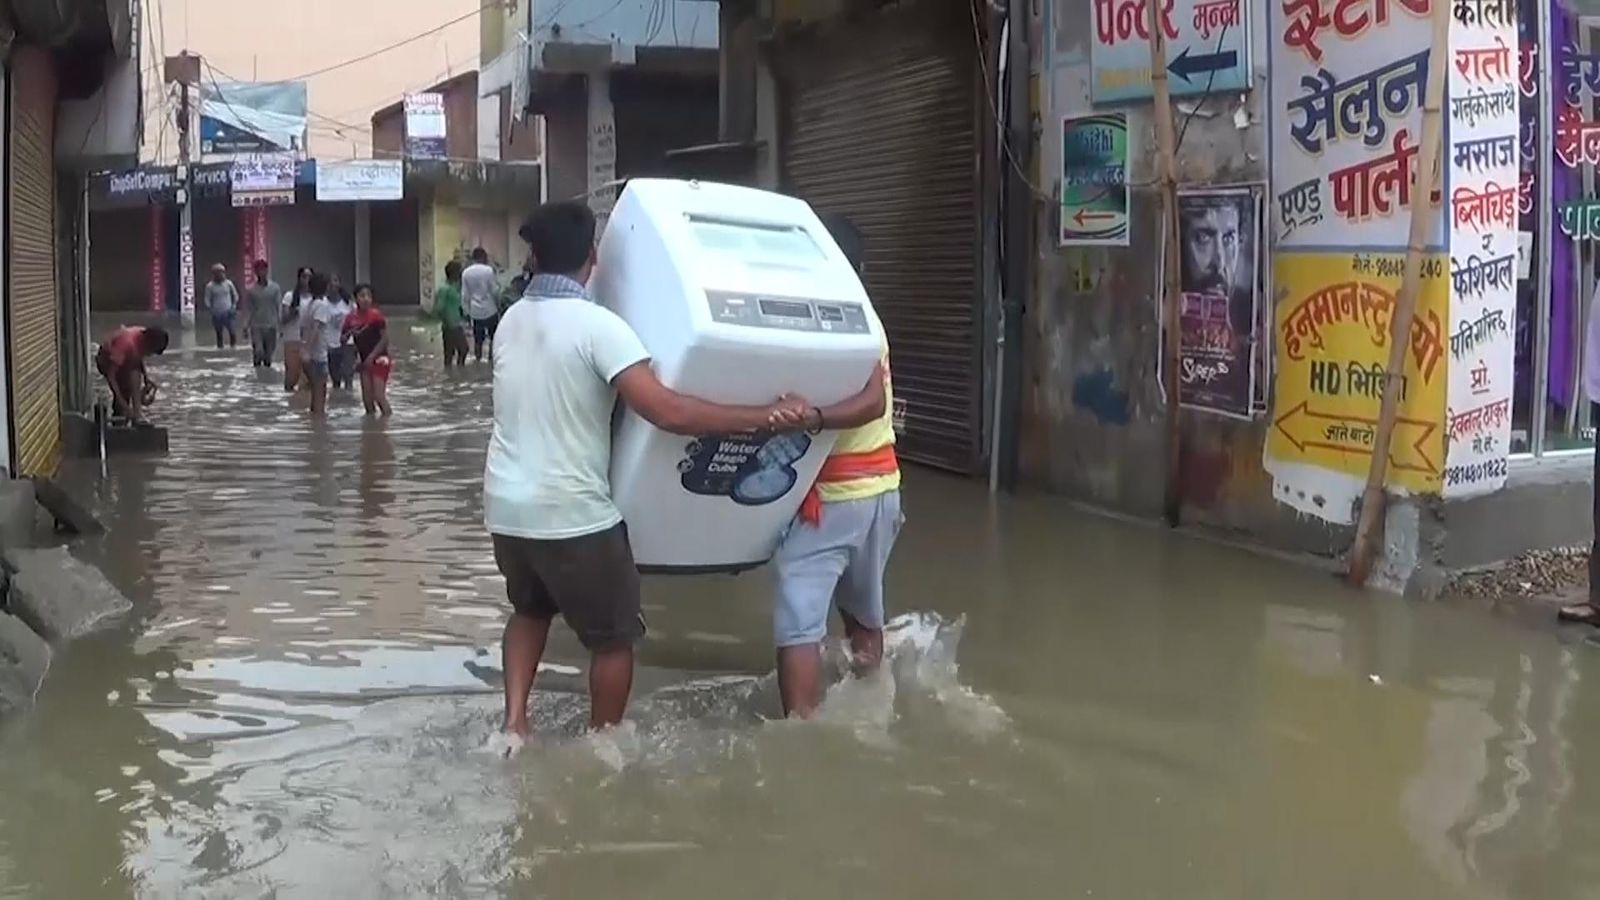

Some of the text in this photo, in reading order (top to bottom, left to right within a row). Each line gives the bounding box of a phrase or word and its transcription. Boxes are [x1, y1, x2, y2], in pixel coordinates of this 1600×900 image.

[1456, 36, 1510, 83] रातो
[1454, 135, 1516, 173] मसाज
[194, 168, 228, 185] Service
[1329, 129, 1441, 219] पार्ल
[1360, 282, 1443, 385] स्टुयो
[1310, 360, 1340, 395] HD
[711, 453, 748, 463] Magic
[718, 441, 761, 454] Water
[708, 462, 739, 473] Cube
